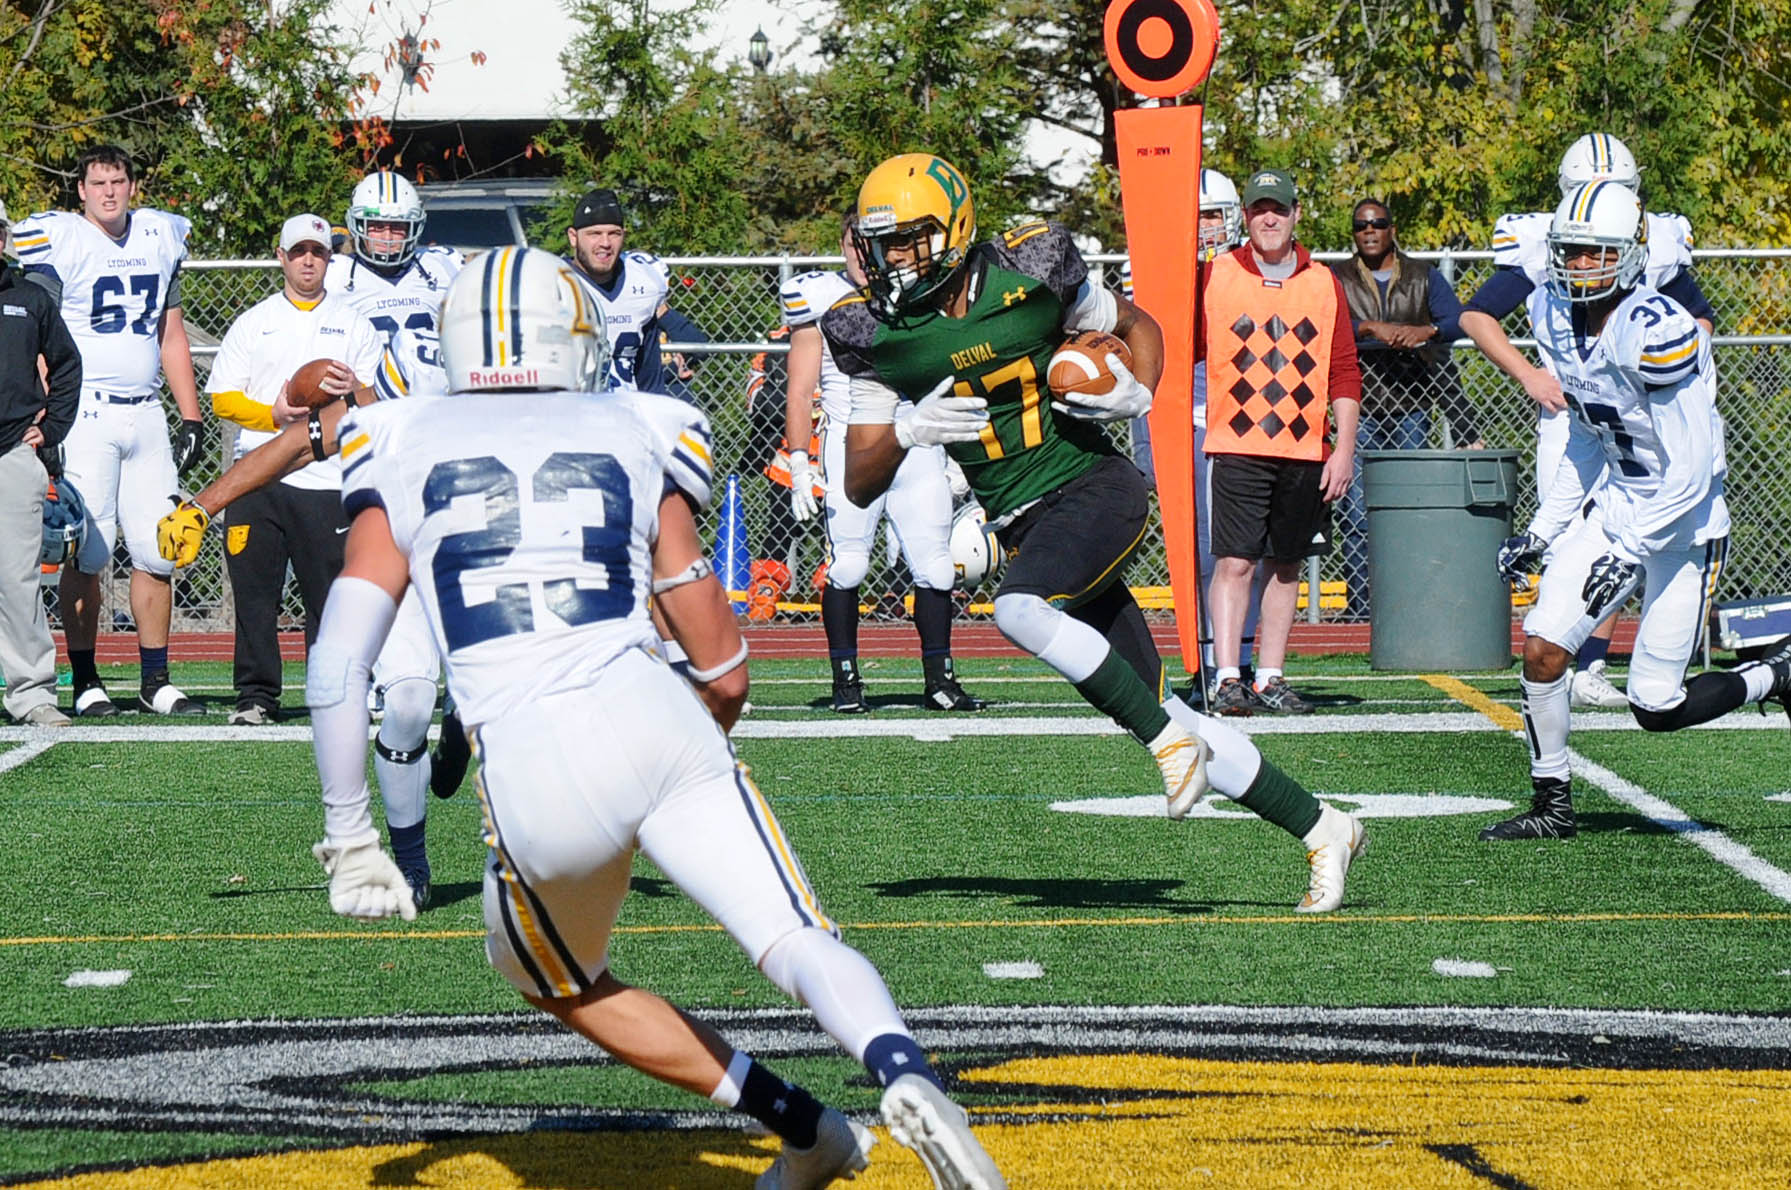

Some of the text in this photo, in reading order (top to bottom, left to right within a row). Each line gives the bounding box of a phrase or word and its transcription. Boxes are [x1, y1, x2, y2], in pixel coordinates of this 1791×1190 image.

[107, 257, 147, 268] LYCOMING
[90, 273, 160, 335] 67
[376, 297, 421, 309] LYCOMING
[1630, 295, 1678, 329] 37
[950, 341, 998, 370] DELVAL
[953, 355, 1043, 460] 17
[422, 452, 636, 653] 23
